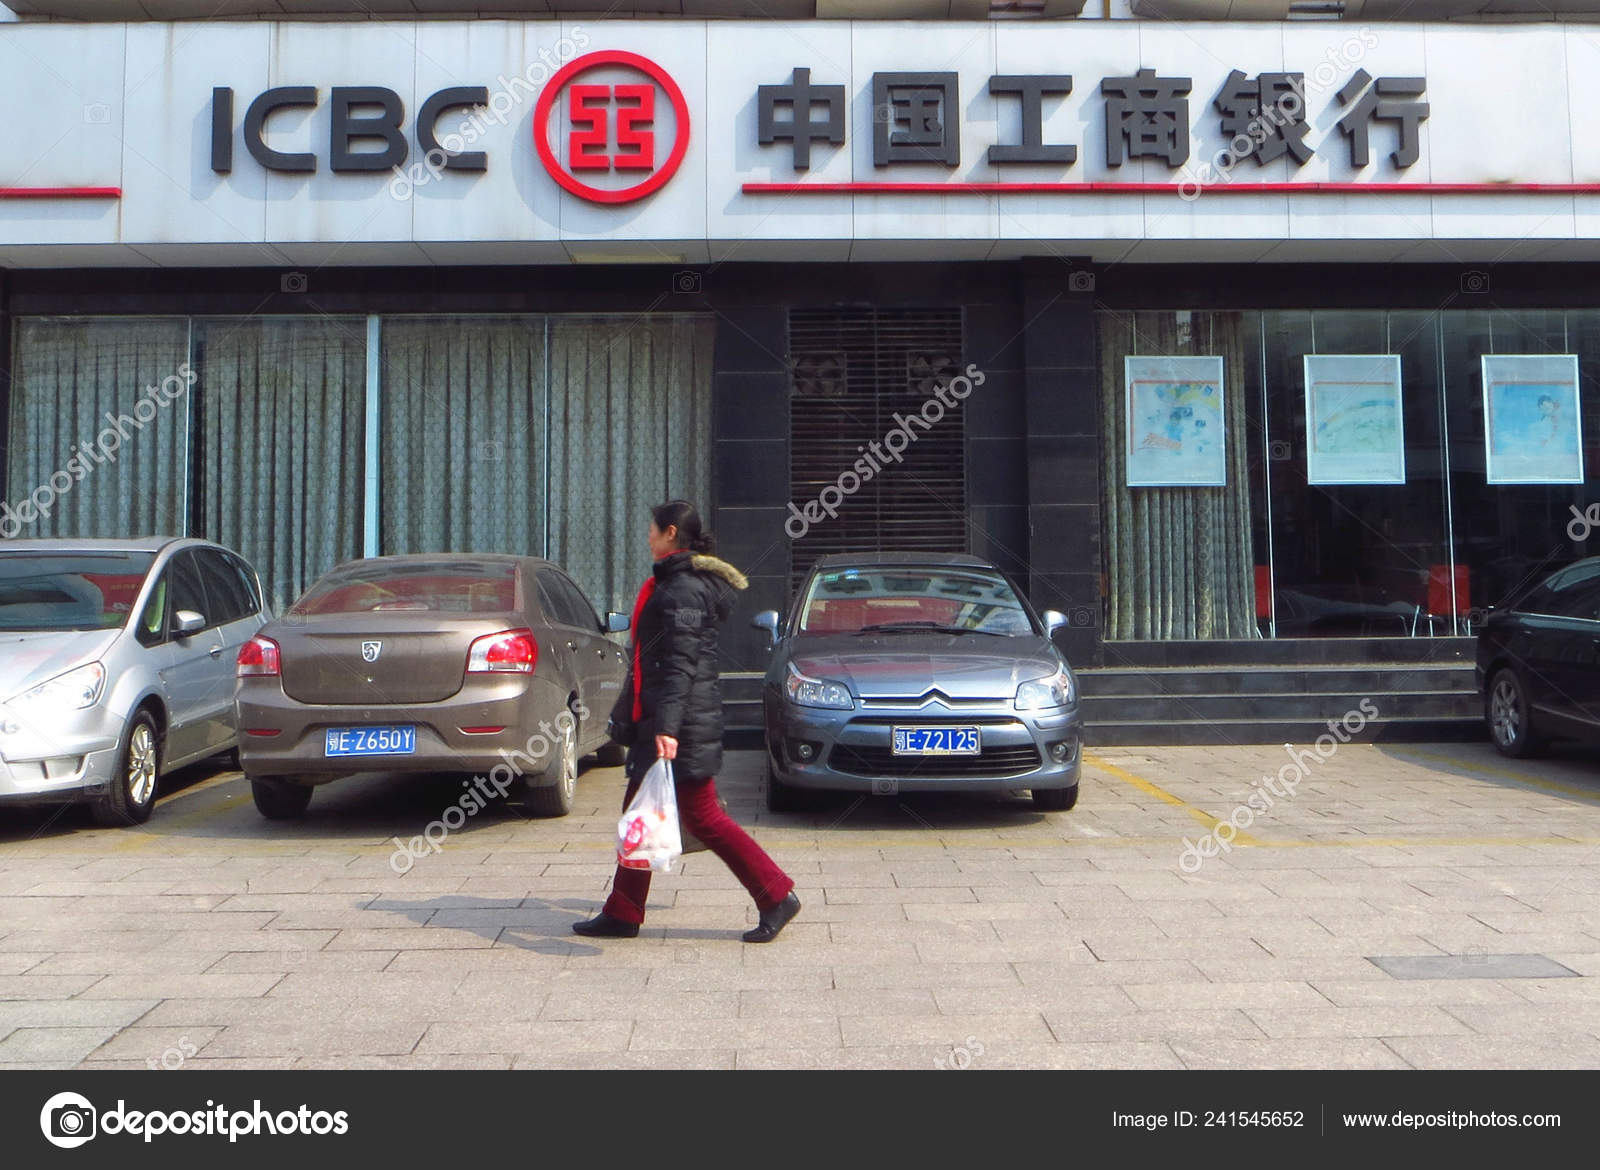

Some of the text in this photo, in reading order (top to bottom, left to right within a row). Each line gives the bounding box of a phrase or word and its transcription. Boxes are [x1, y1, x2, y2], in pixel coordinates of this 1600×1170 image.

[211, 86, 488, 174] ICBC
[757, 67, 1430, 170] 中国工商银行
